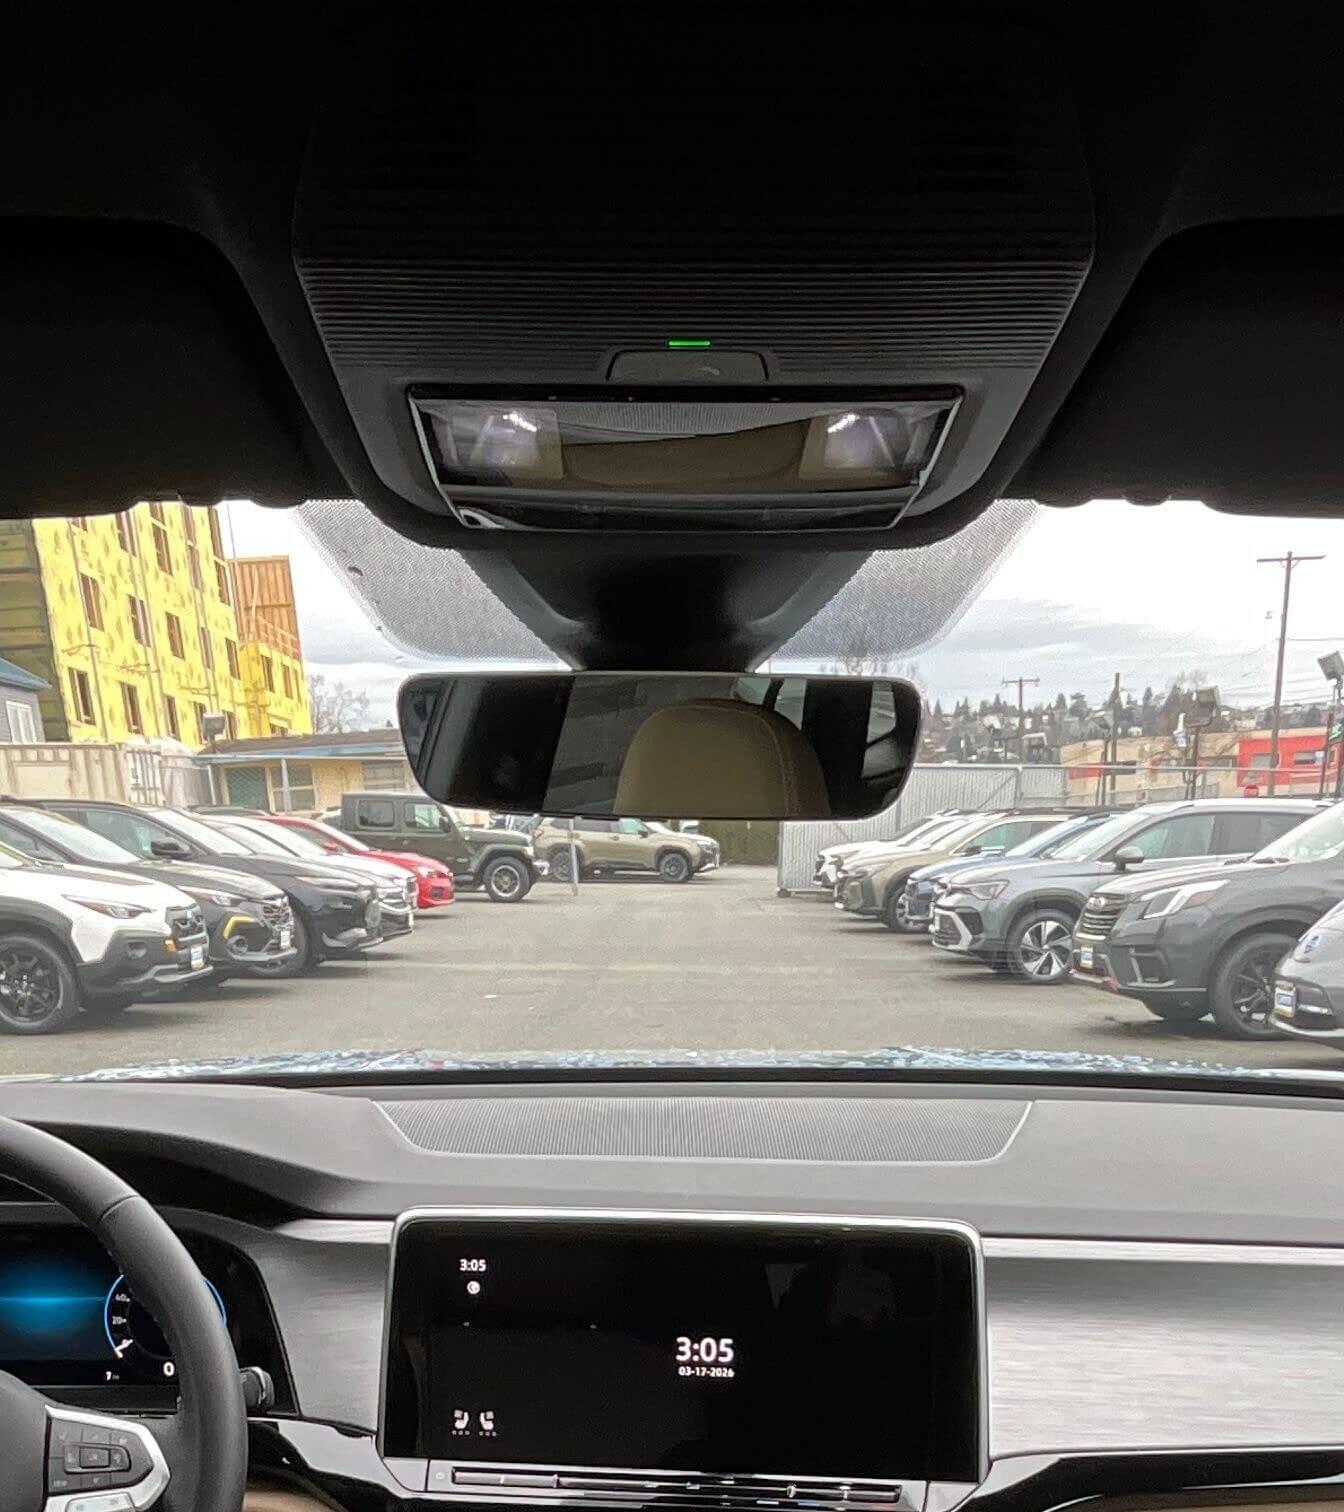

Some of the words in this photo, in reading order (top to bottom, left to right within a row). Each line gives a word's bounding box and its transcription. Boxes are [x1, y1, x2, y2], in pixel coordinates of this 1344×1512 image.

[459, 1258, 486, 1271] 3:05
[675, 1336, 734, 1362] 3:05
[163, 1361, 175, 1376] 0
[678, 1366, 735, 1378] 03-17-2026
